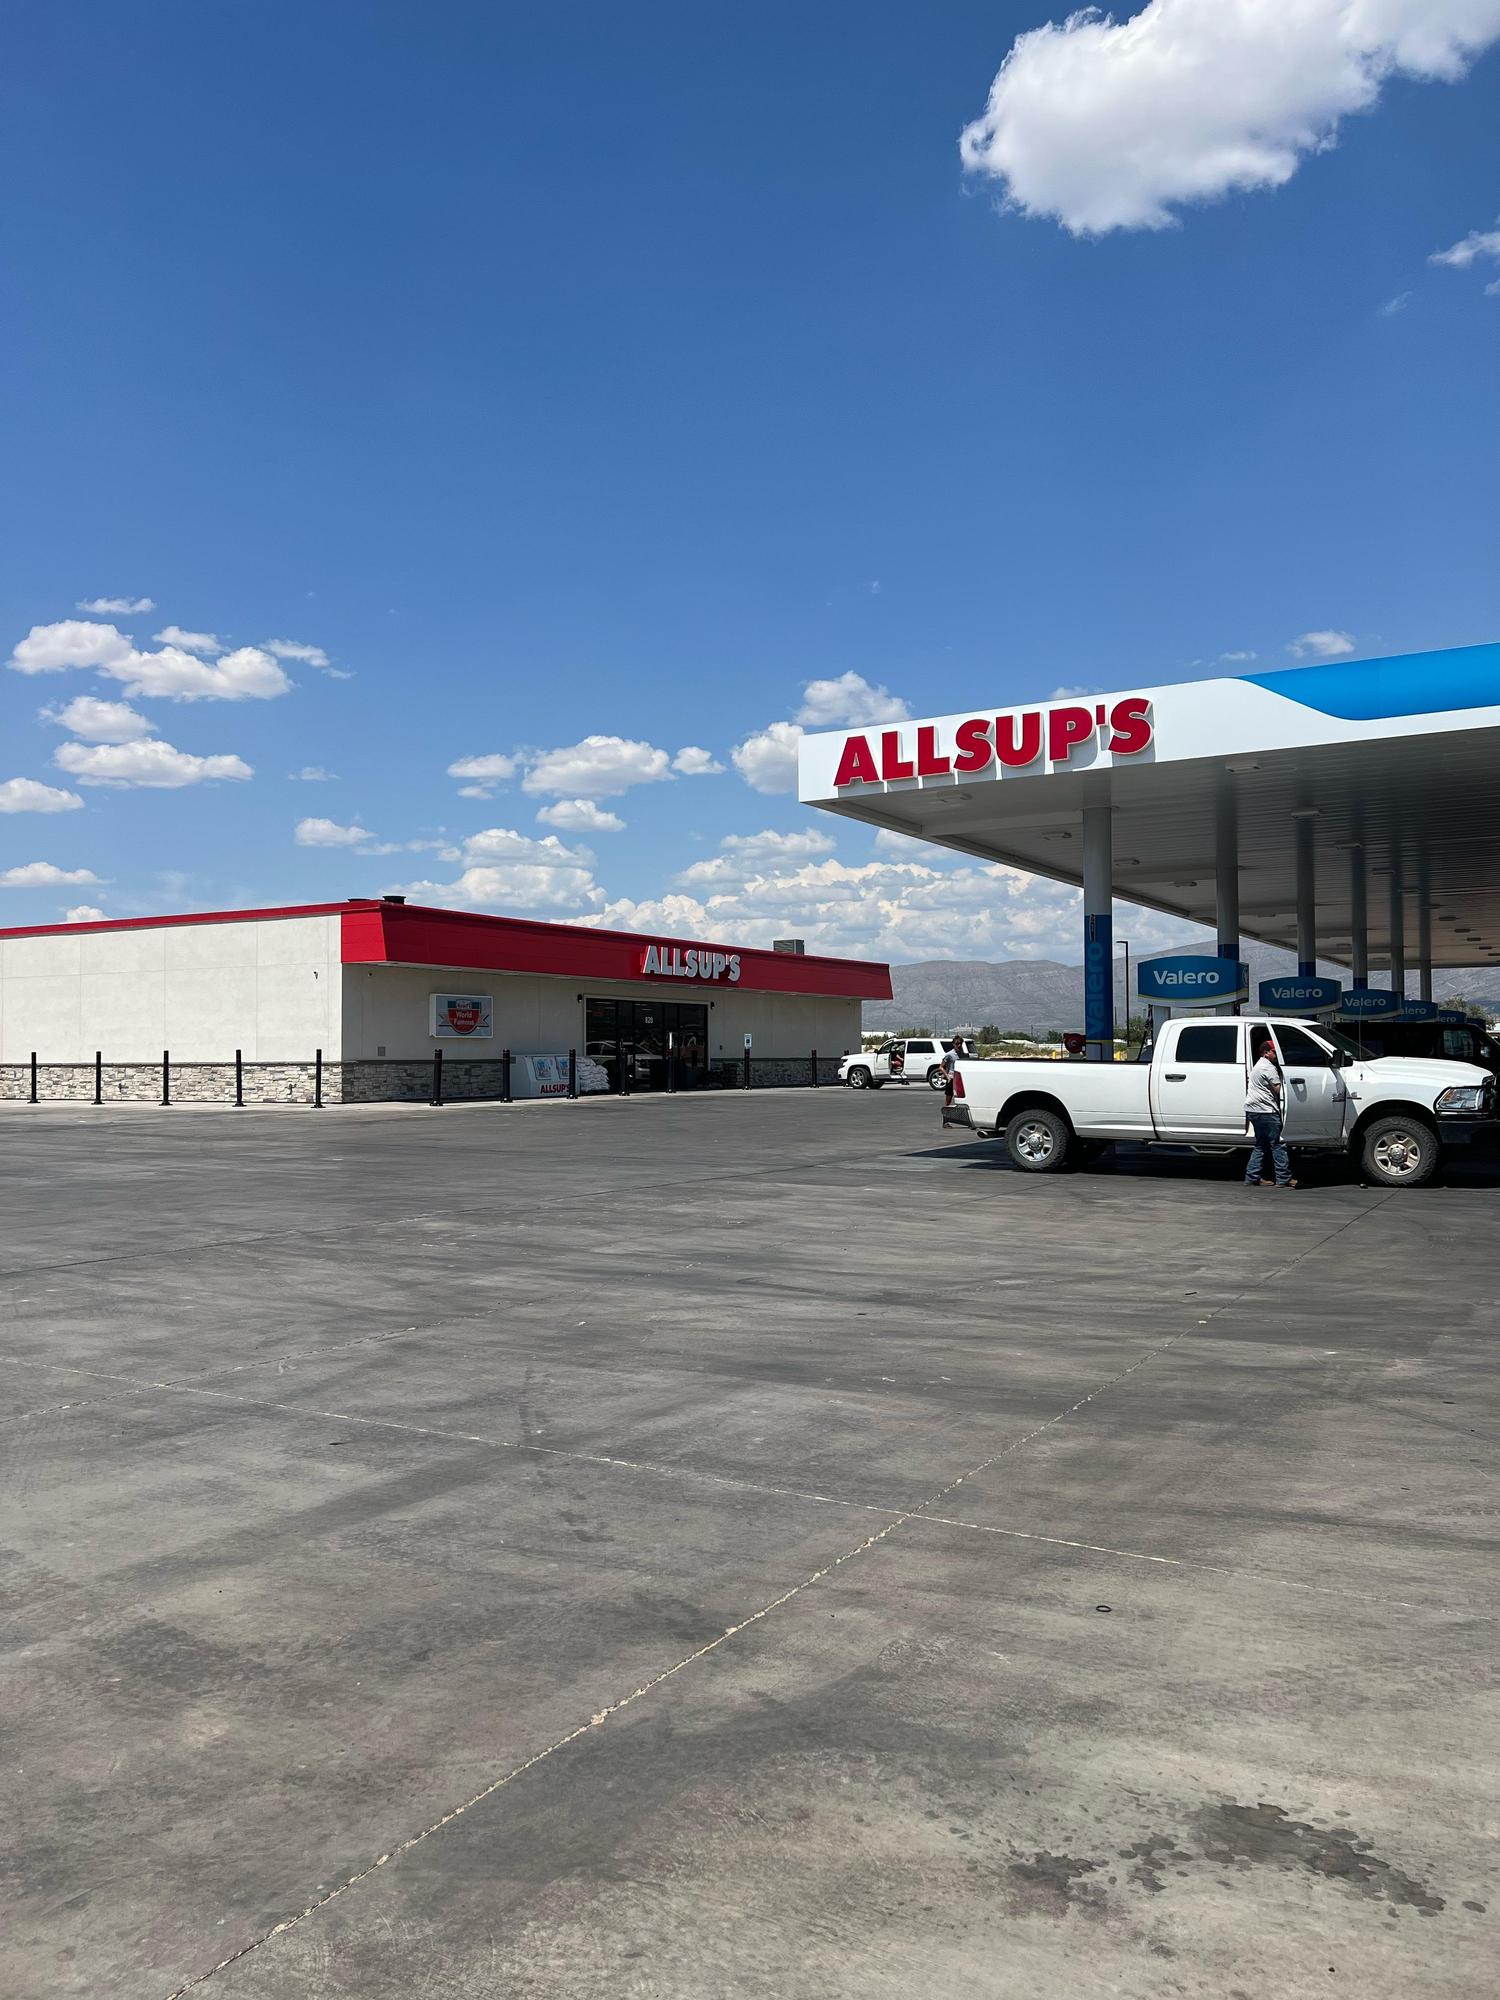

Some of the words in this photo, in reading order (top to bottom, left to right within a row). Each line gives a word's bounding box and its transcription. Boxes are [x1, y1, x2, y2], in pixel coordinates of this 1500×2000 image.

[833, 698, 1154, 787] ALLSUP'S
[642, 945, 741, 982] ALLSUP'S
[1153, 970, 1220, 985] Valero
[1271, 987, 1323, 999] Valero
[1344, 997, 1386, 1007] Valero
[1399, 1007, 1427, 1015] alero
